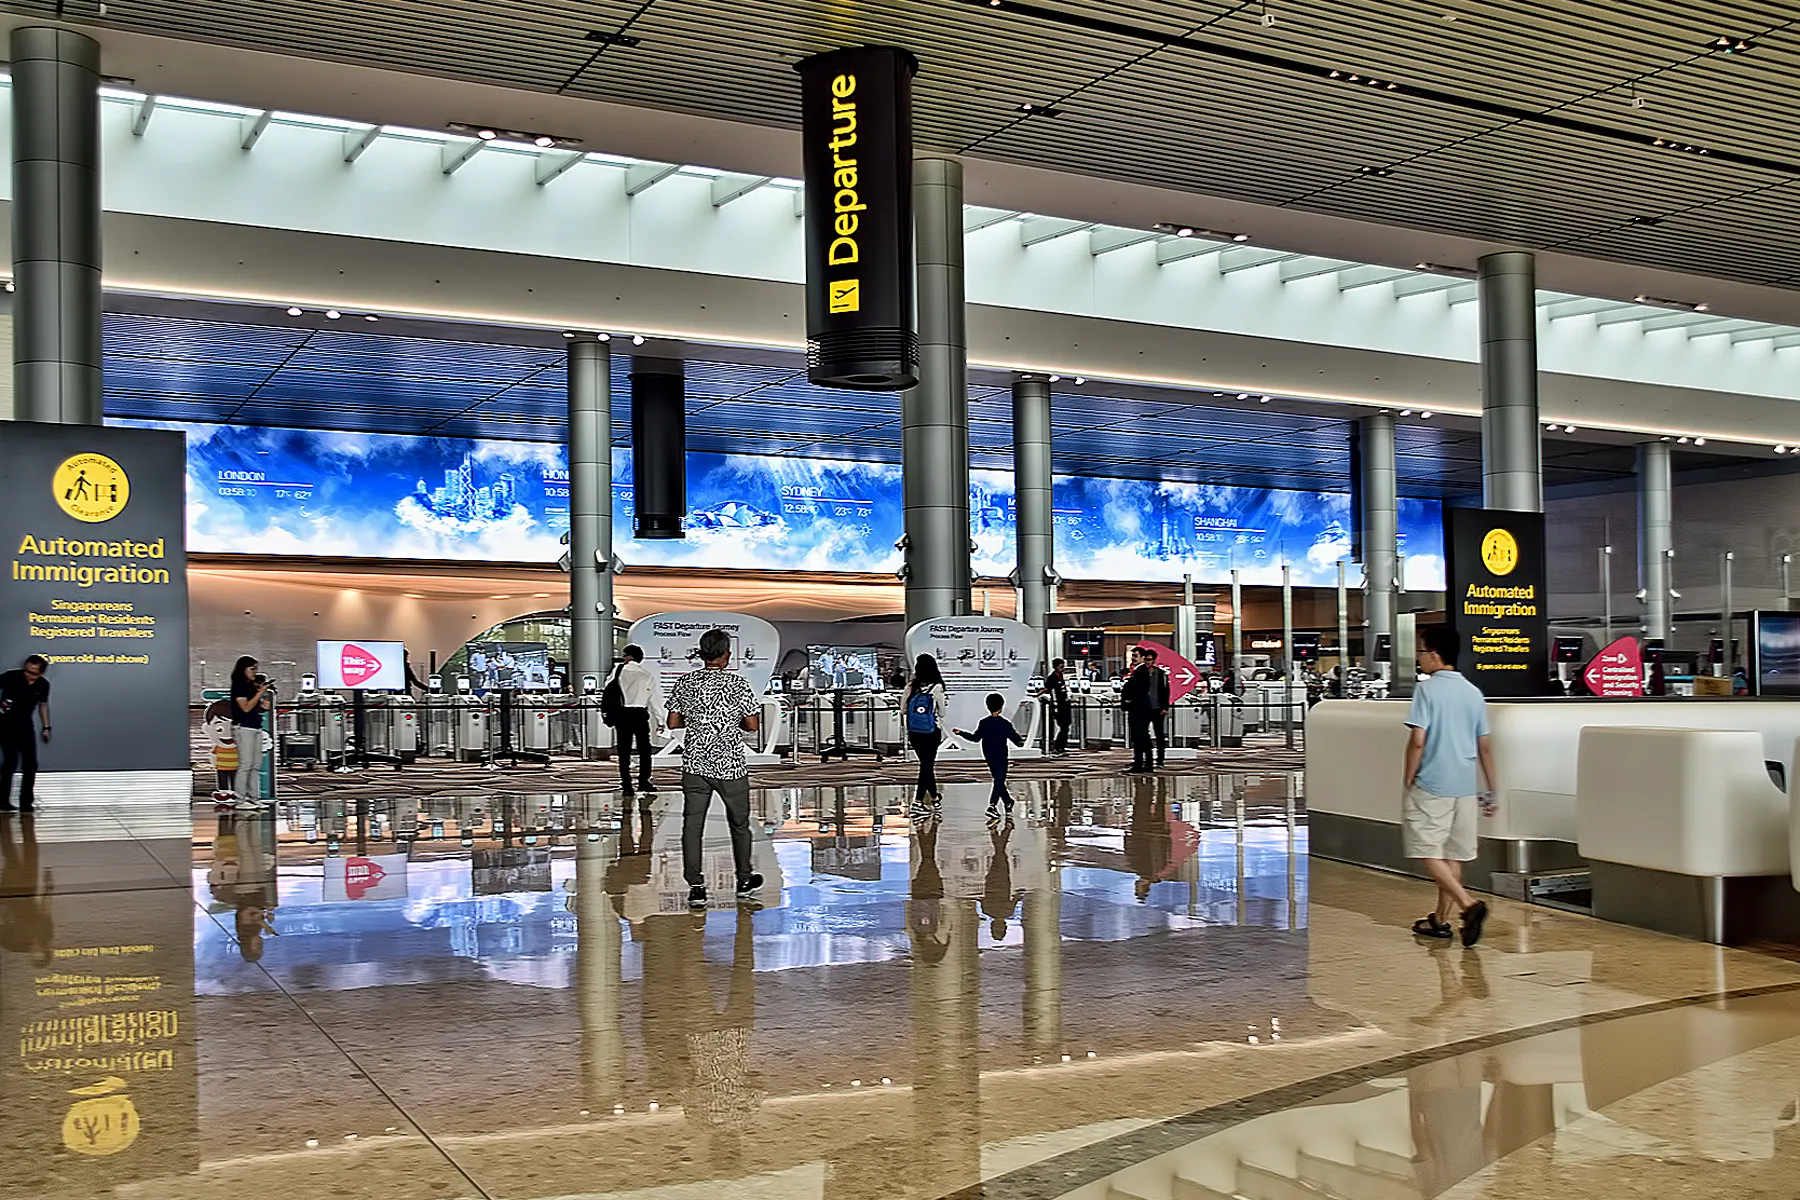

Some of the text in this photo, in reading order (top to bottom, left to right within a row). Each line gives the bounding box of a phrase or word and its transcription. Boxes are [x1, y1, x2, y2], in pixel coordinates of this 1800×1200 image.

[827, 73, 868, 267] Departure
[67, 457, 118, 474] Automated
[218, 470, 265, 481] LONDON
[543, 469, 570, 480] HON
[781, 485, 823, 497] SYDNEY
[1194, 516, 1238, 527] SHANGHAI
[18, 535, 165, 559] Automated
[13, 561, 170, 587] Immigration
[1466, 583, 1534, 599] Automated
[51, 599, 134, 612] Singaporeans
[1463, 601, 1537, 619] Immigration
[29, 612, 155, 625] Permanent Residents
[30, 626, 154, 639] Registered Travellers
[653, 622, 675, 630] FAST
[674, 622, 711, 632] Departure
[929, 625, 1005, 634] FAST Departure Journey
[48, 654, 76, 664] years
[77, 654, 94, 663] old
[95, 654, 114, 663] and
